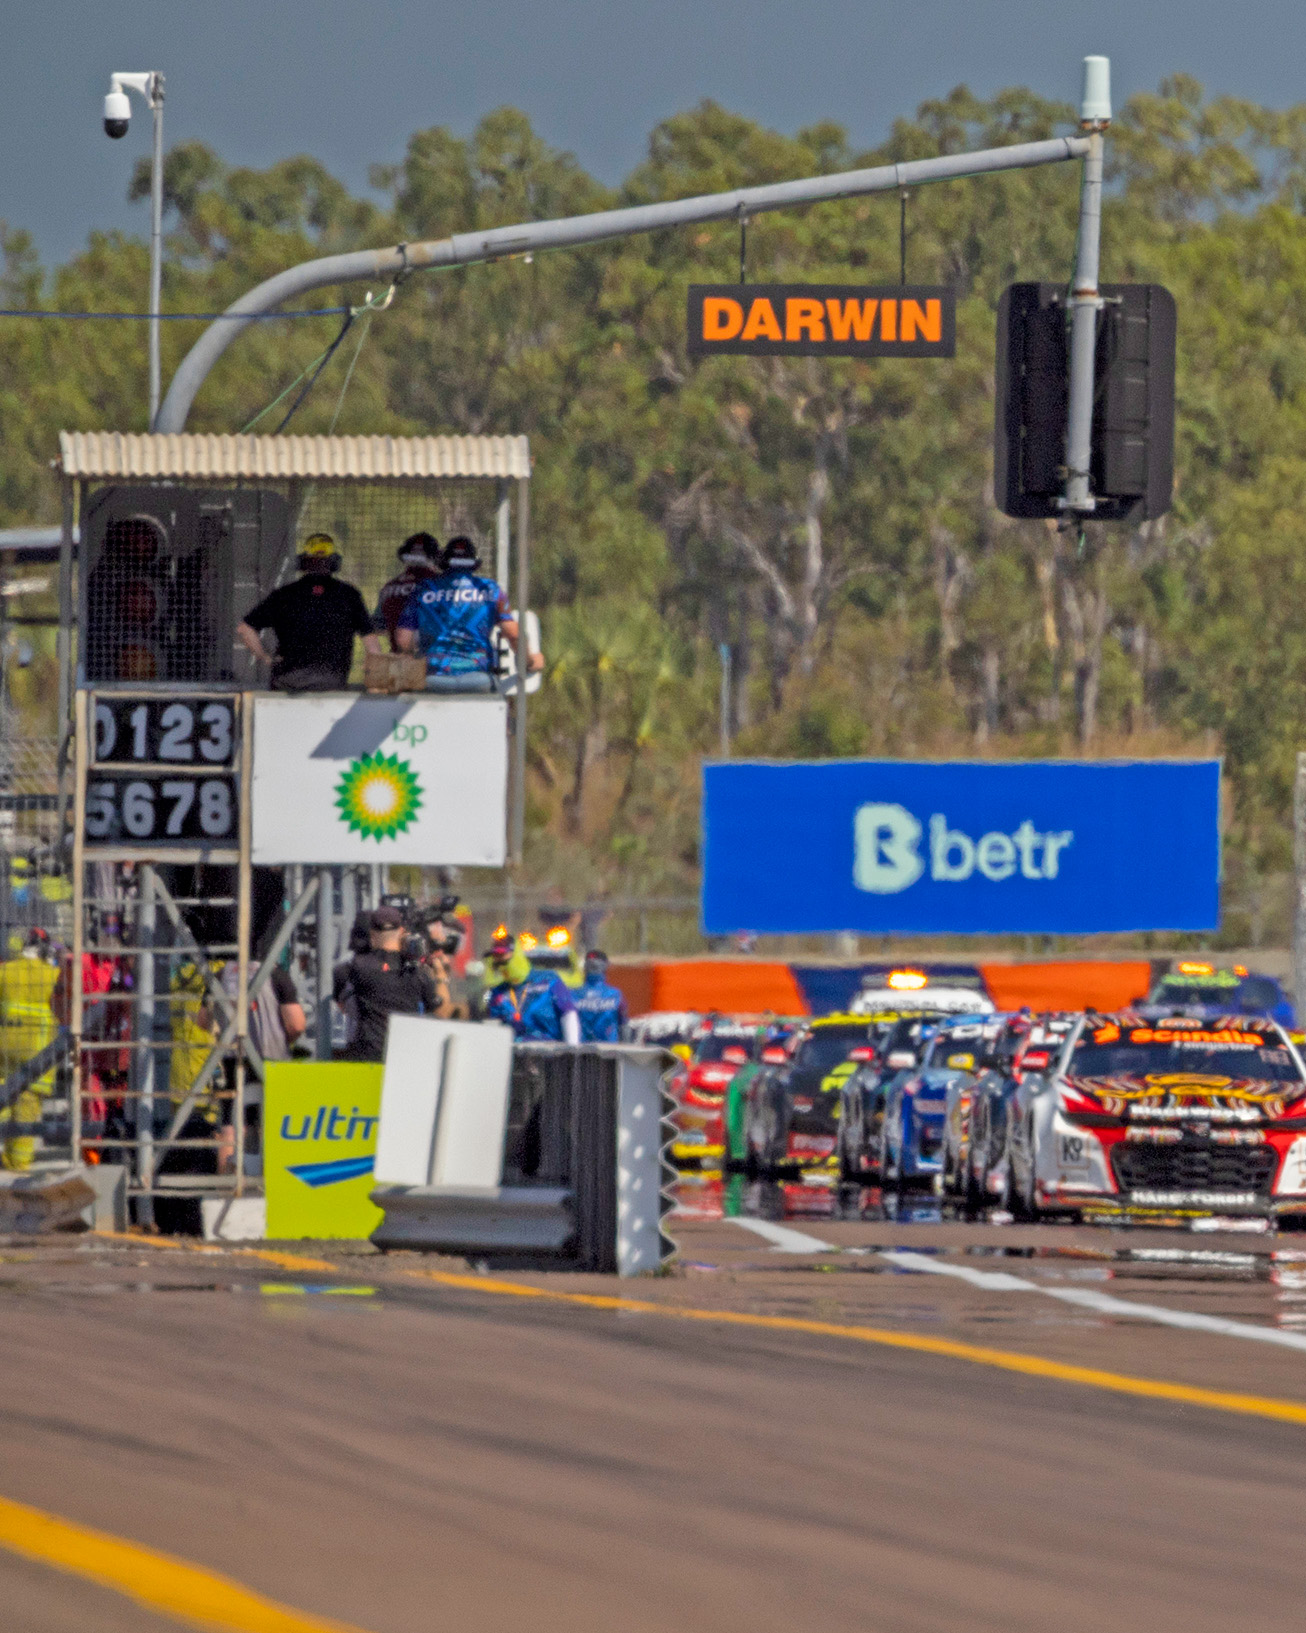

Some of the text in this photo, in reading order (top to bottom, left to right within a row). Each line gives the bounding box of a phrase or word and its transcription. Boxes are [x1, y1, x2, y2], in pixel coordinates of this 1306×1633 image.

[702, 297, 943, 342] DARWIN
[393, 719, 428, 747] bp
[86, 780, 233, 836] 5678
[929, 812, 1074, 882] betr
[1129, 1028, 1265, 1046] Scandia
